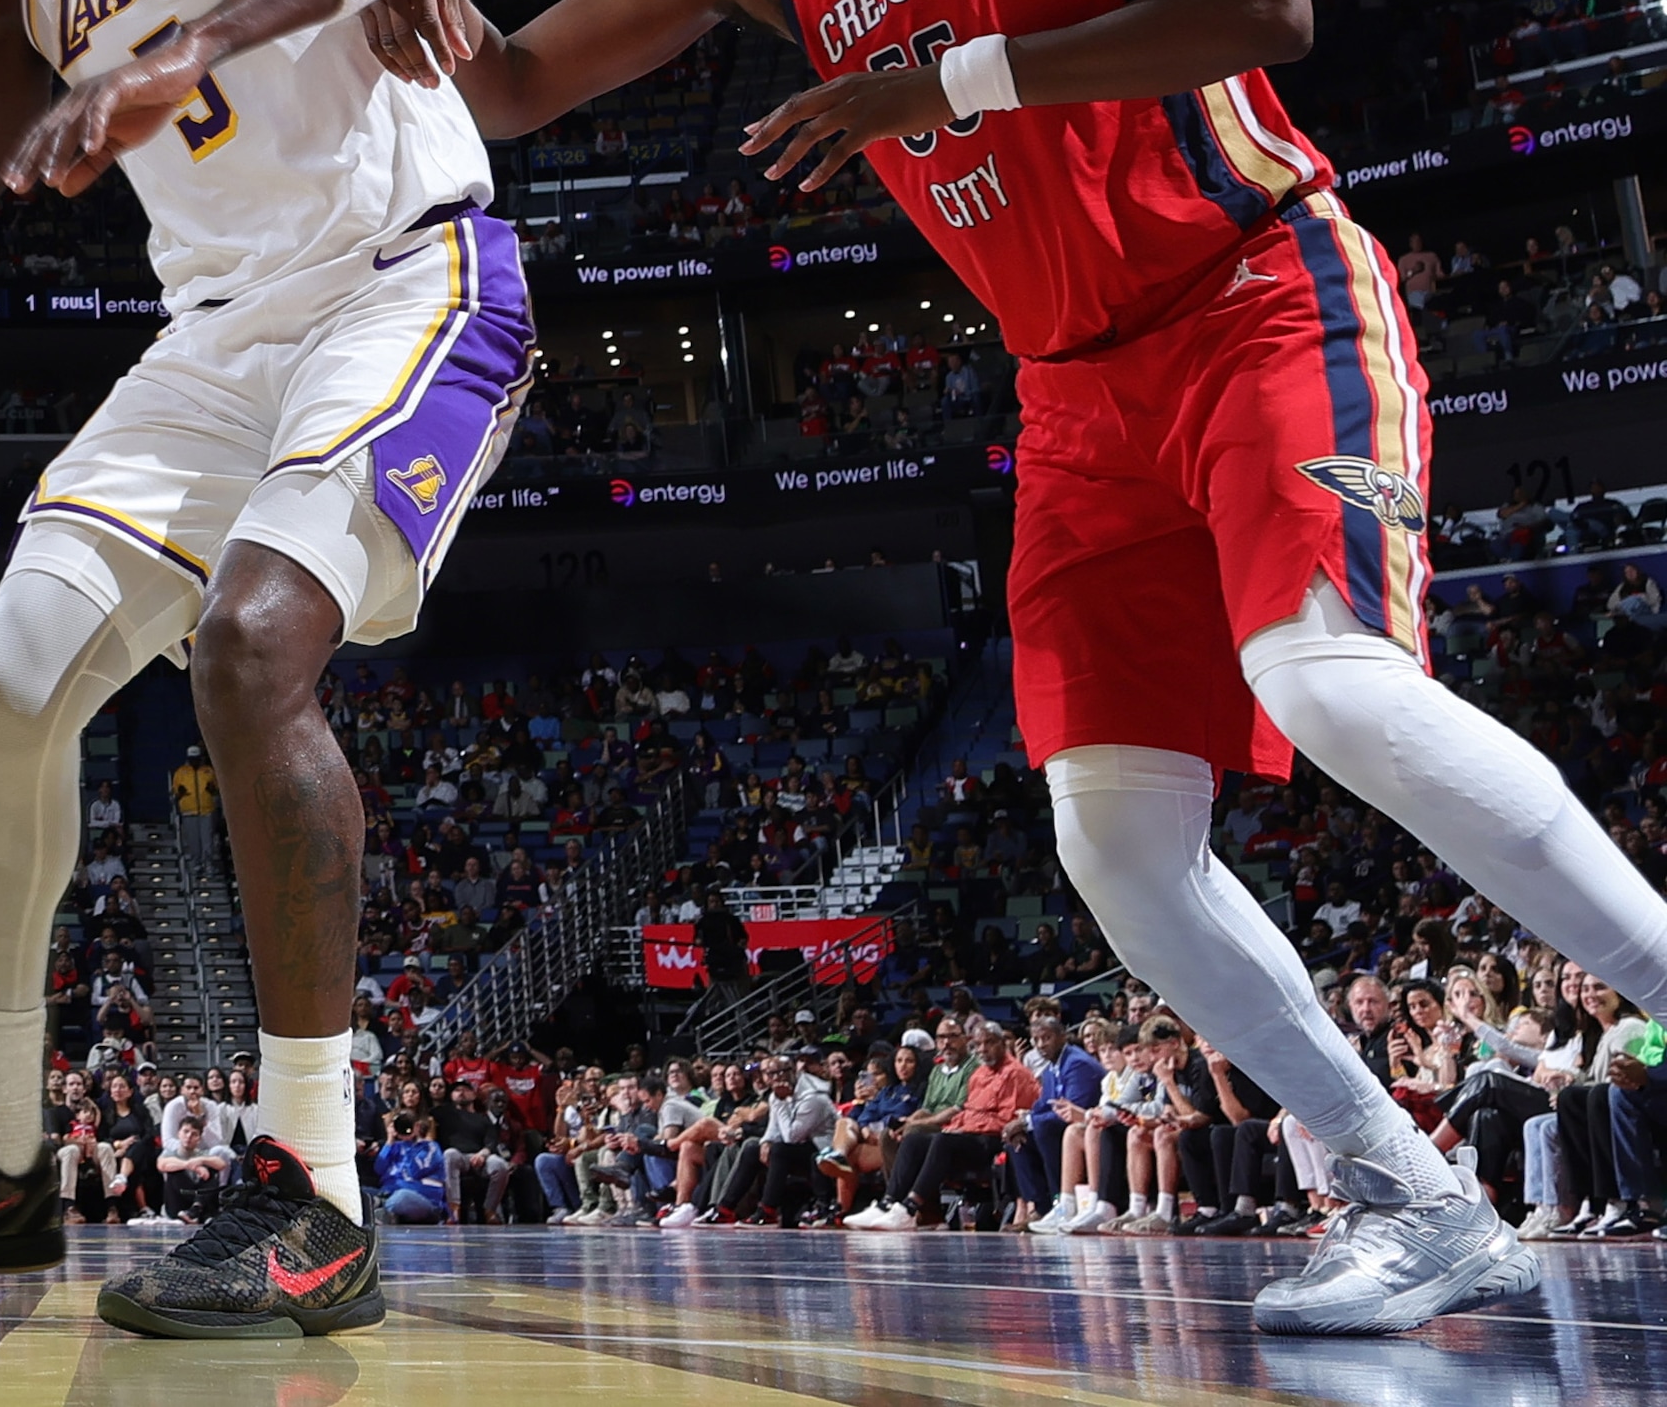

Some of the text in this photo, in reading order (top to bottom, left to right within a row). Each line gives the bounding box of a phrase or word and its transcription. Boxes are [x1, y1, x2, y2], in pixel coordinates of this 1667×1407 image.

[1540, 114, 1632, 149] entergy
[1346, 161, 1408, 189] power
[1412, 148, 1449, 171] life.
[929, 154, 1010, 229] CITY
[796, 241, 878, 267] entergy
[578, 259, 712, 284] We power life.
[25, 295, 36, 312] 1
[51, 296, 94, 311] FOULS
[105, 298, 170, 317] enterg
[1562, 360, 1667, 393] We powe
[1430, 389, 1508, 417] ntergy
[776, 470, 808, 490] We
[816, 466, 882, 491] power
[469, 490, 506, 509] wer
[639, 483, 726, 505] entergy
